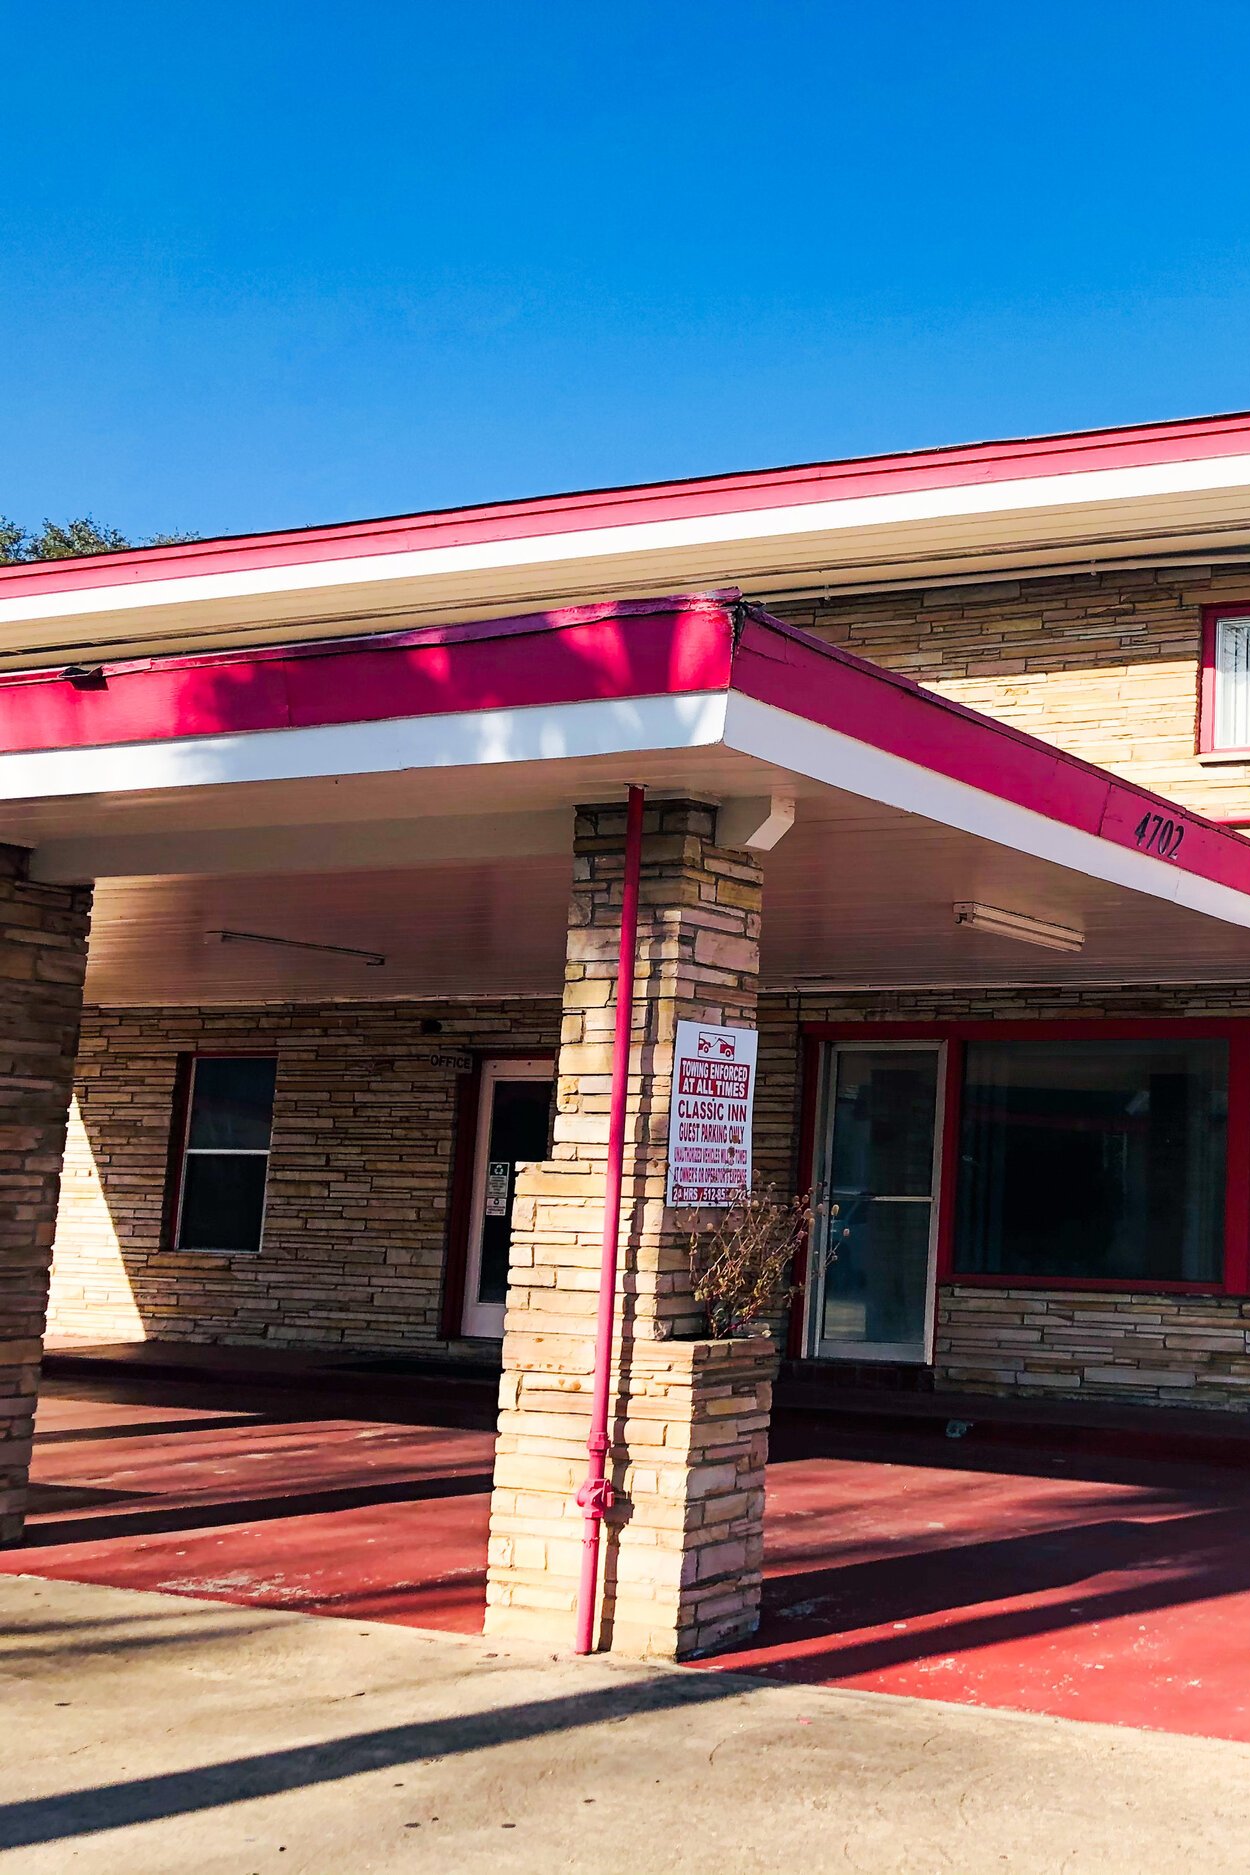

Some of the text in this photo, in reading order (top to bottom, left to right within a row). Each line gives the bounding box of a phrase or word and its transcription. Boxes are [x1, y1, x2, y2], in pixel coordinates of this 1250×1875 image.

[1134, 812, 1185, 860] 4702
[430, 1054, 471, 1069] OFFICE
[682, 1060, 748, 1082] TOWING ENFORCED
[682, 1077, 745, 1097] AT ALL TIMES
[678, 1099, 747, 1122] CLASSIC INN
[679, 1122, 700, 1142] GUEST
[701, 1123, 727, 1144] PARKING
[683, 1188, 698, 1201] HRS
